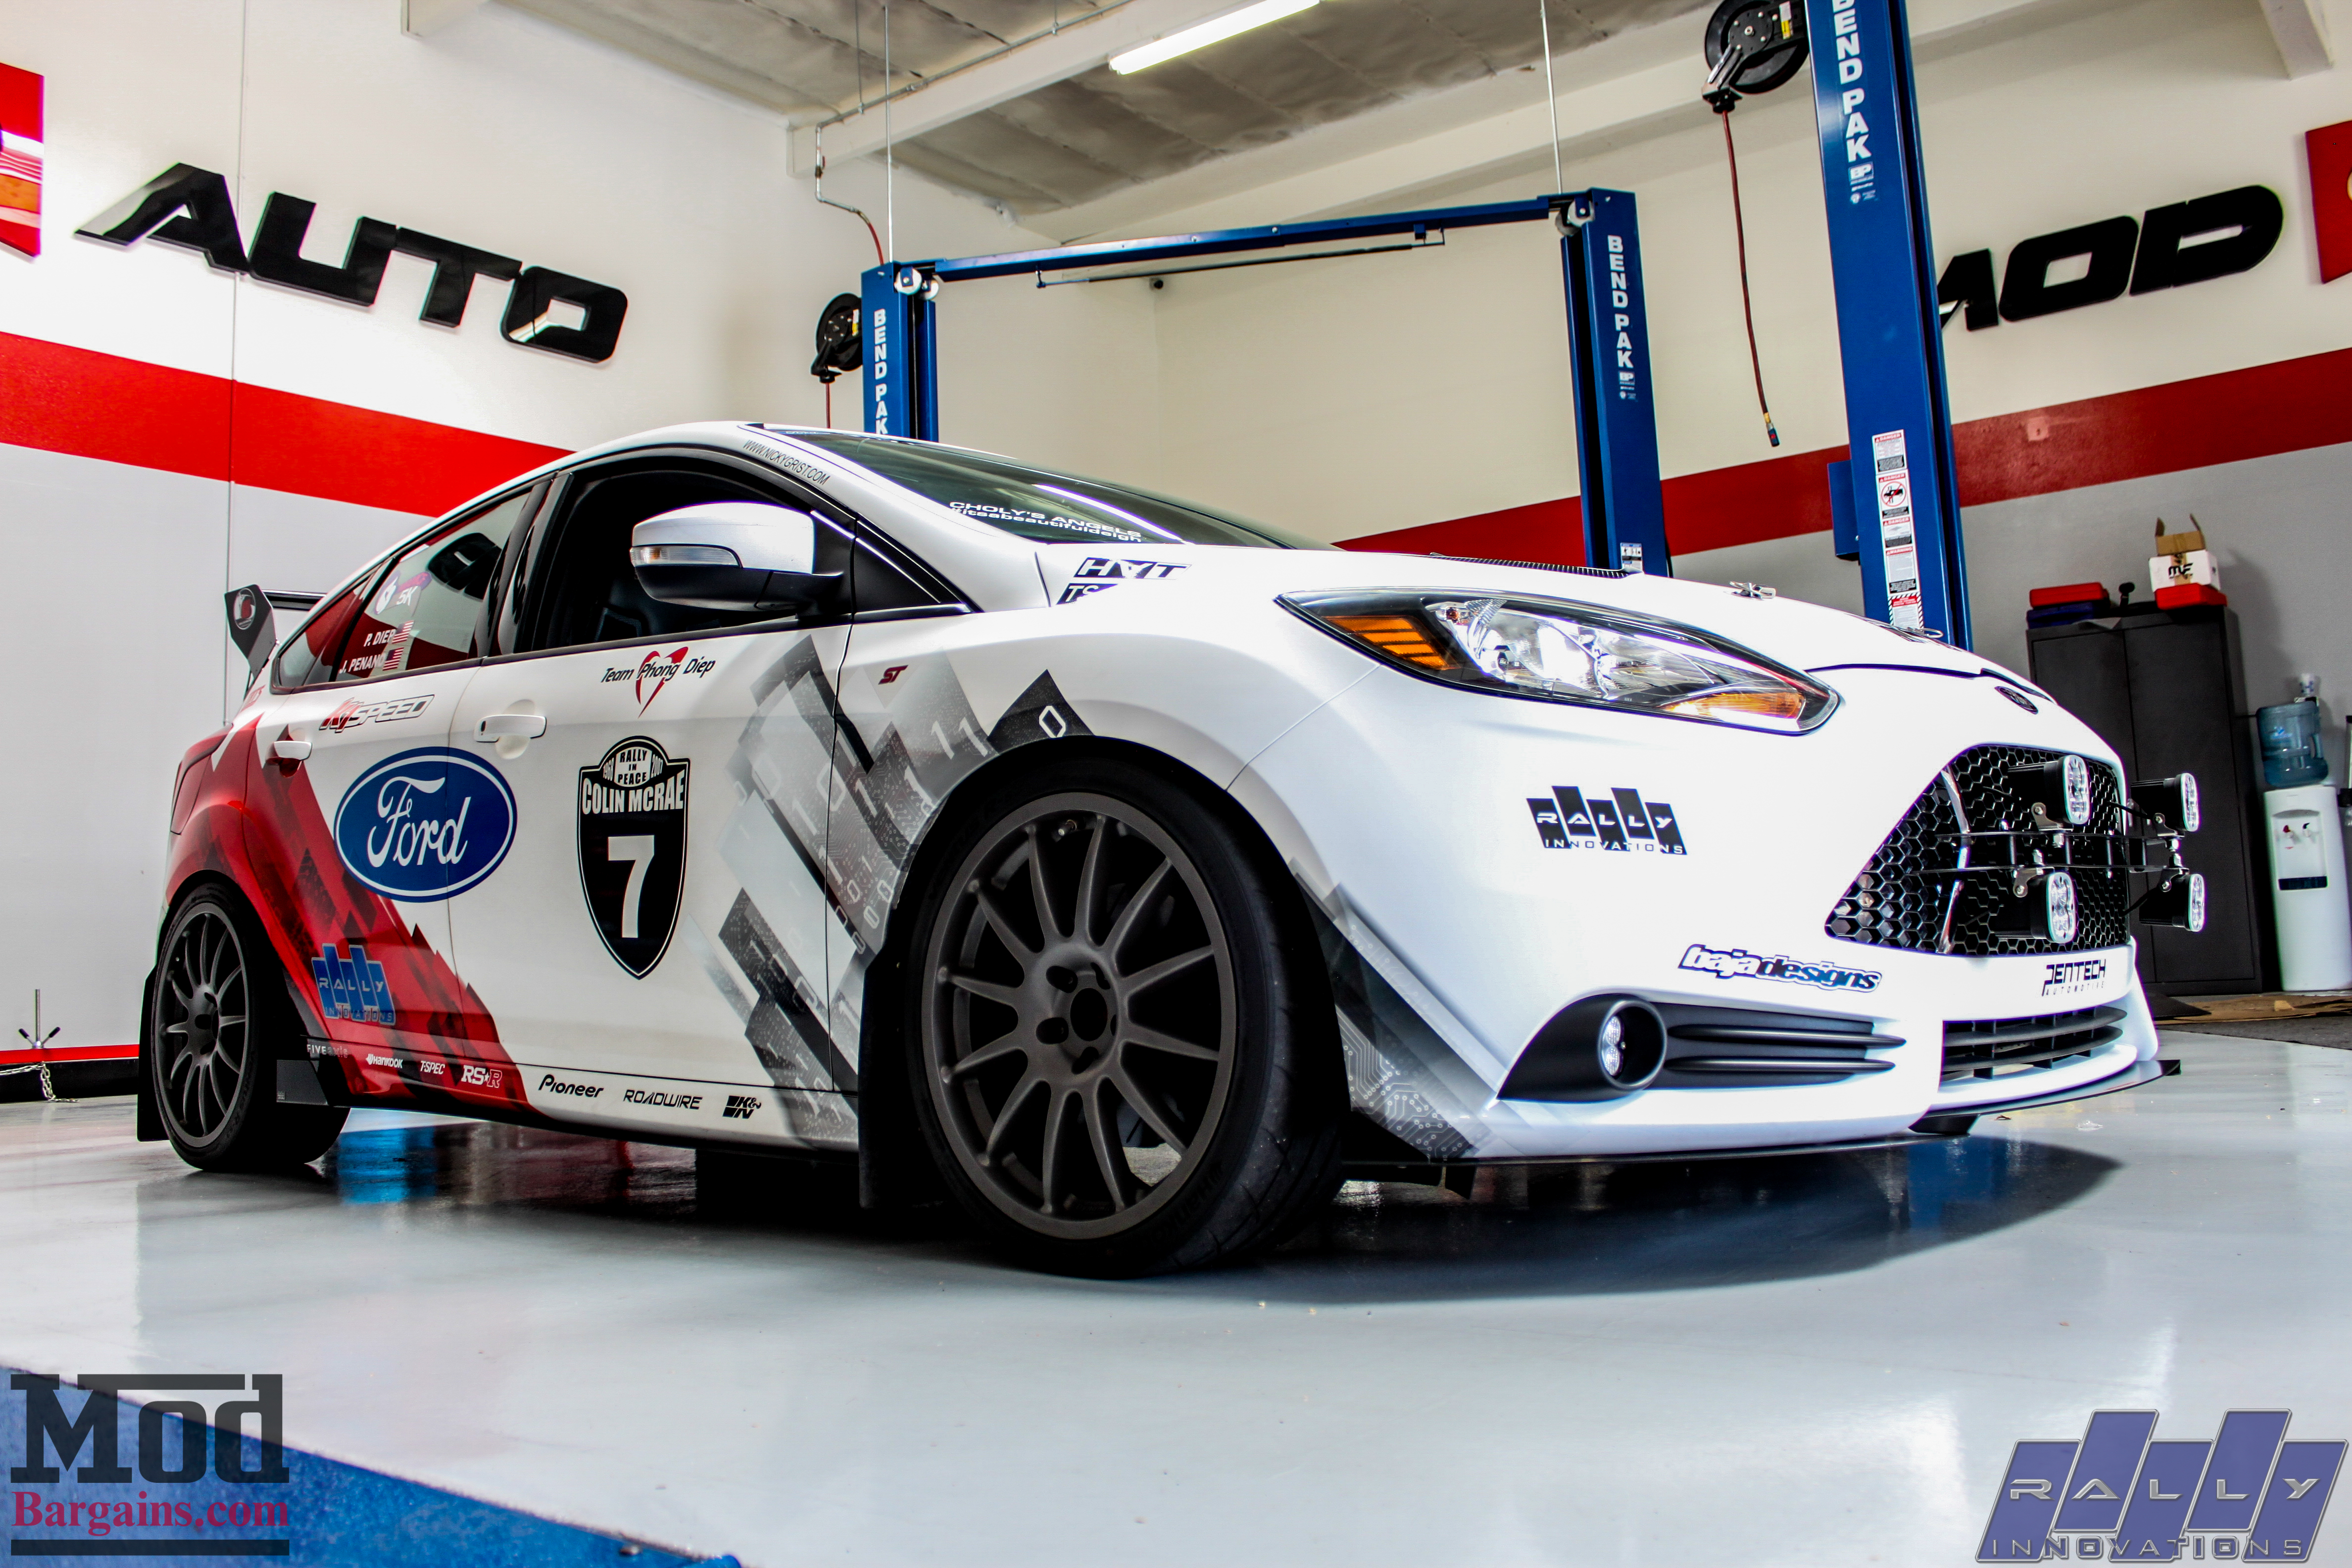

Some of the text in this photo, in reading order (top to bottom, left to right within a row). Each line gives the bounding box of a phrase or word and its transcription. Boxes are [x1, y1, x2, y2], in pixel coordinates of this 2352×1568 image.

[1842, 88, 1871, 162] PAK
[74, 162, 628, 364] AUTO
[1607, 235, 1628, 308] BEND
[1615, 313, 1634, 368] PAK
[874, 308, 888, 435] BEND PAK
[742, 439, 831, 486] WWW.NICKYGRIST.COM
[949, 501, 1141, 538] CHOLY'S ANGELS
[372, 629, 396, 645] DIEP
[601, 656, 716, 683] Team Phong Diep
[878, 665, 908, 685] ST
[620, 749, 647, 763] RALLY
[582, 769, 685, 815] COLIN MCRAE
[618, 772, 647, 785] PEACE
[367, 776, 472, 867] Ford
[1536, 812, 1672, 828] RALLY
[1545, 839, 1683, 854] INNOVATIONS
[607, 834, 655, 938] 7
[318, 978, 384, 992] RALLY
[2042, 959, 2107, 997] PENTECH
[325, 1007, 393, 1022] INNOVATIONS
[538, 1074, 604, 1098] Pioneer
[623, 1089, 703, 1110] ROADWIRE
